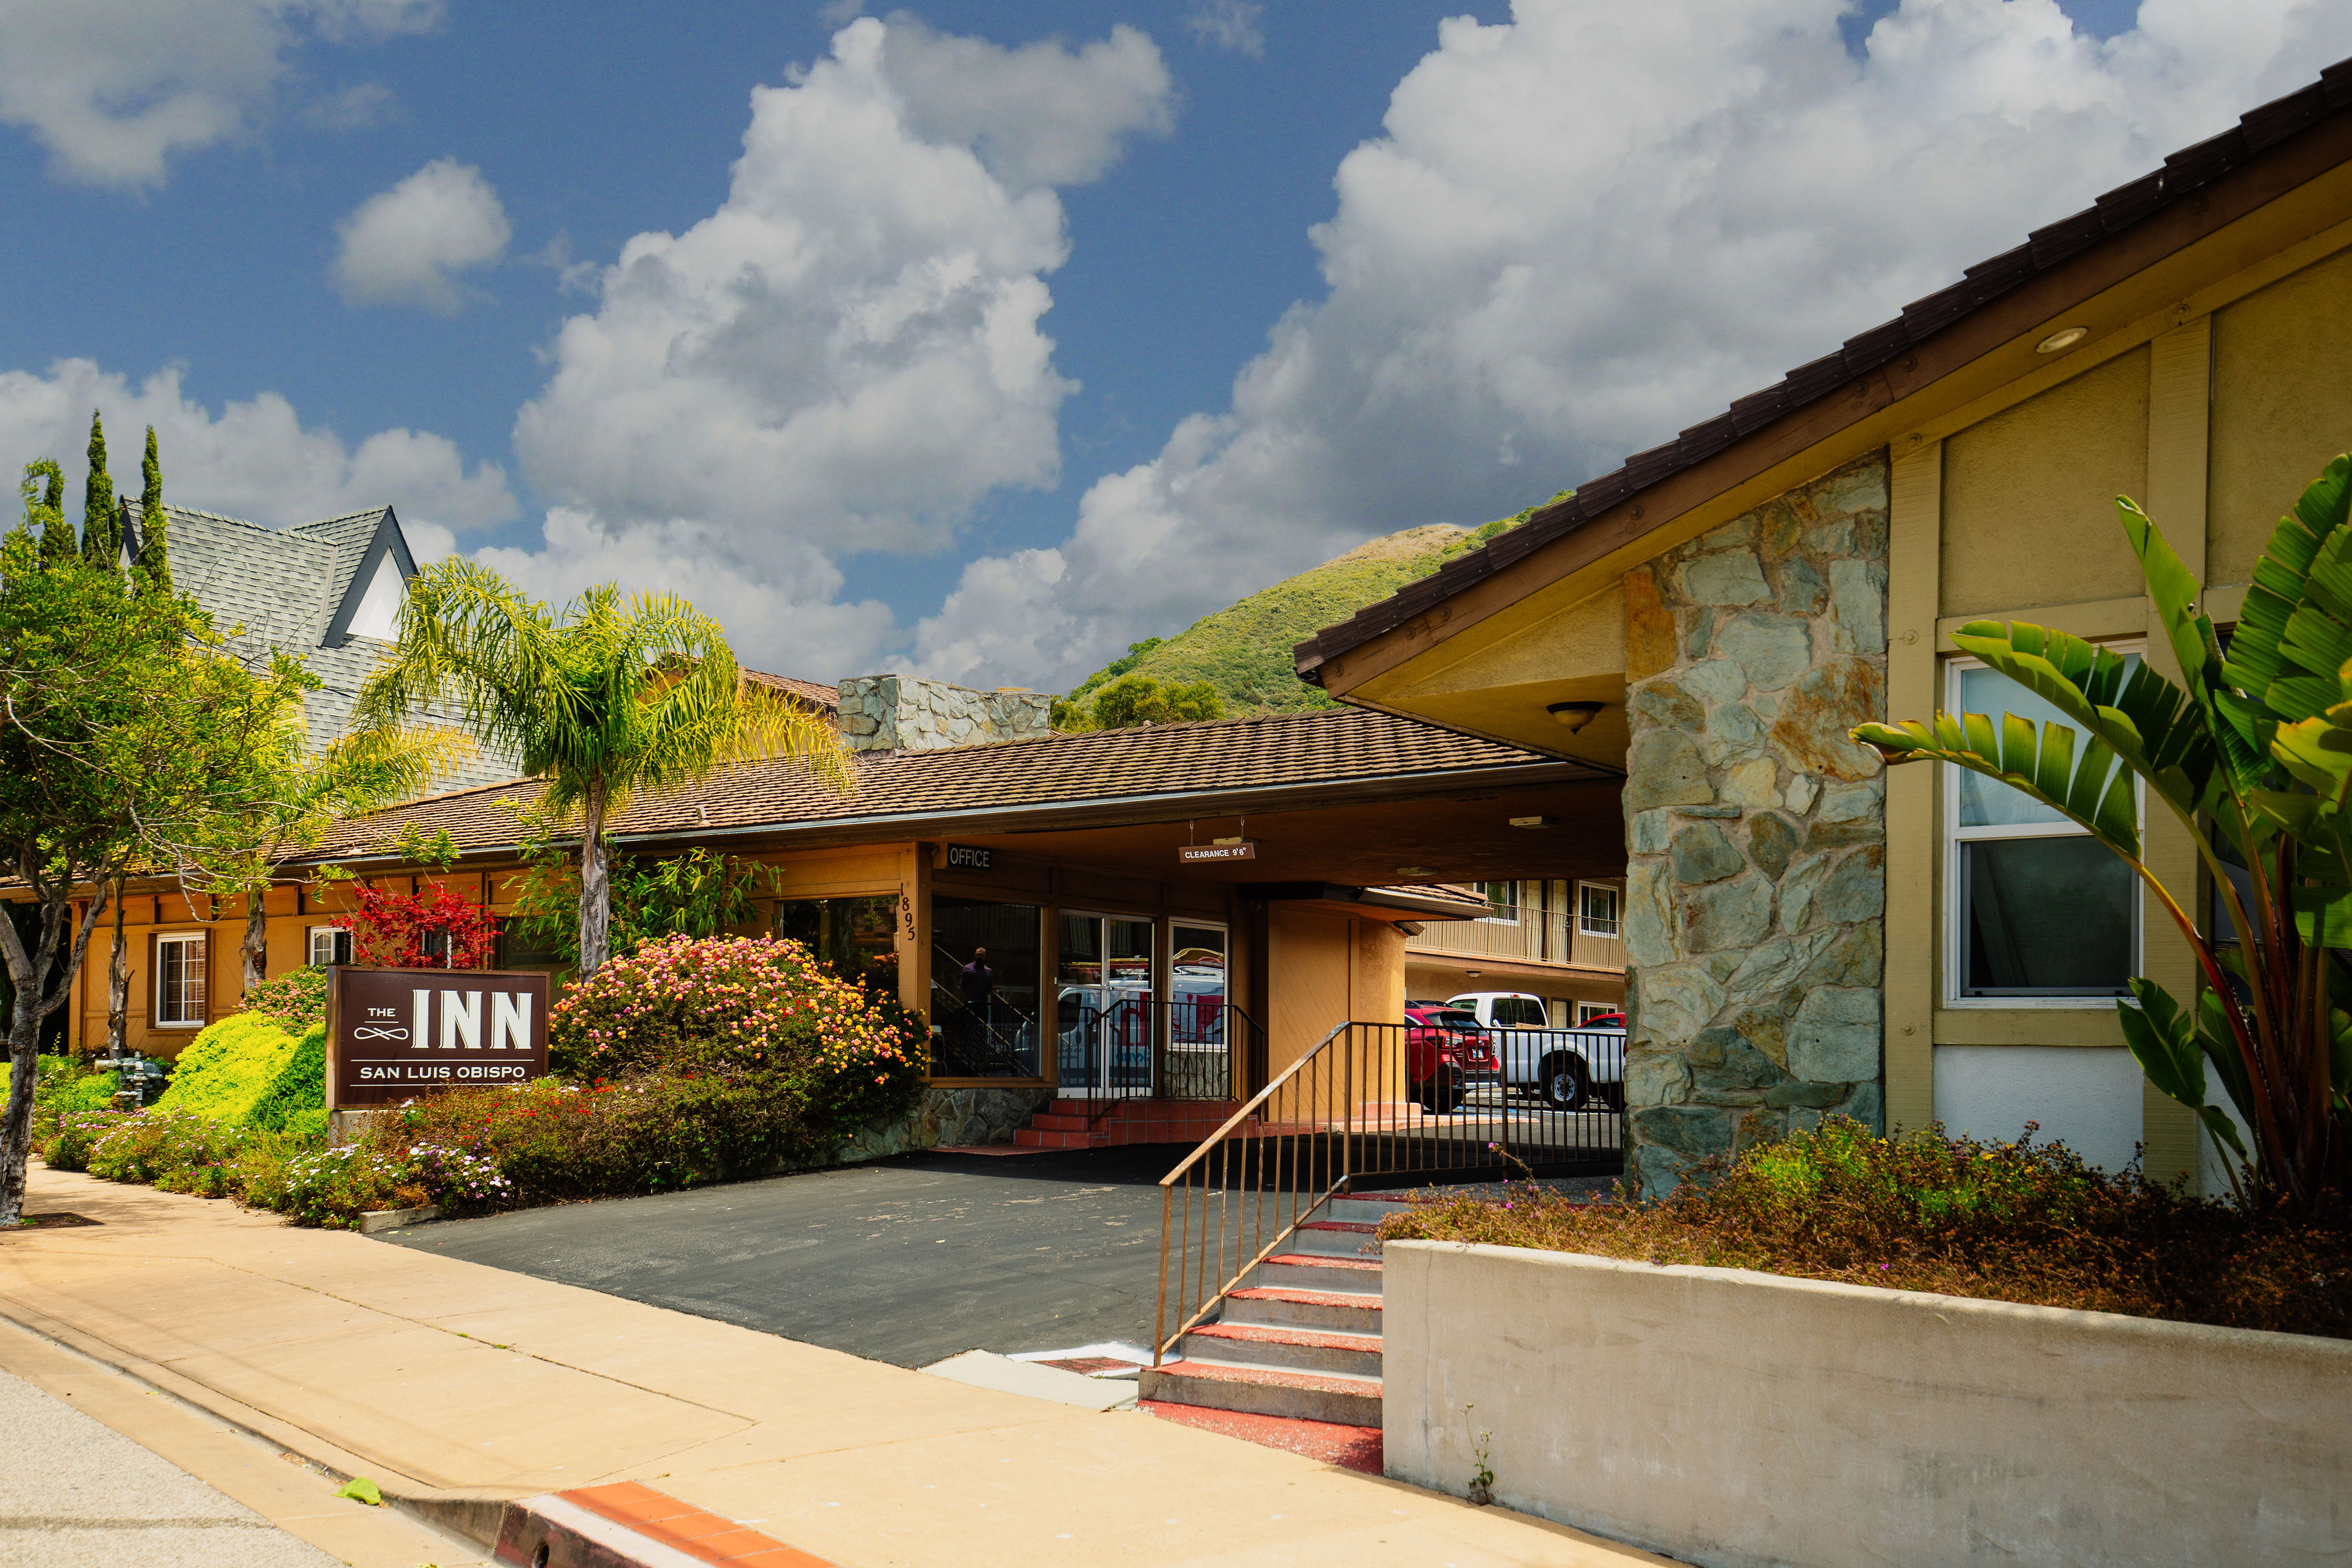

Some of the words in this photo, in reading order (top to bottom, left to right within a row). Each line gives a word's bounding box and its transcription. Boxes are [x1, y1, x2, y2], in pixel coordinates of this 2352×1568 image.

[950, 847, 990, 868] OFFICE
[1184, 849, 1230, 858] CLEARANCE
[900, 883, 915, 941] 1895
[367, 1007, 396, 1017] THE
[411, 989, 533, 1049] INN
[360, 1067, 400, 1079] SAN
[407, 1066, 451, 1079] LUIS
[457, 1066, 525, 1079] OBISPO
